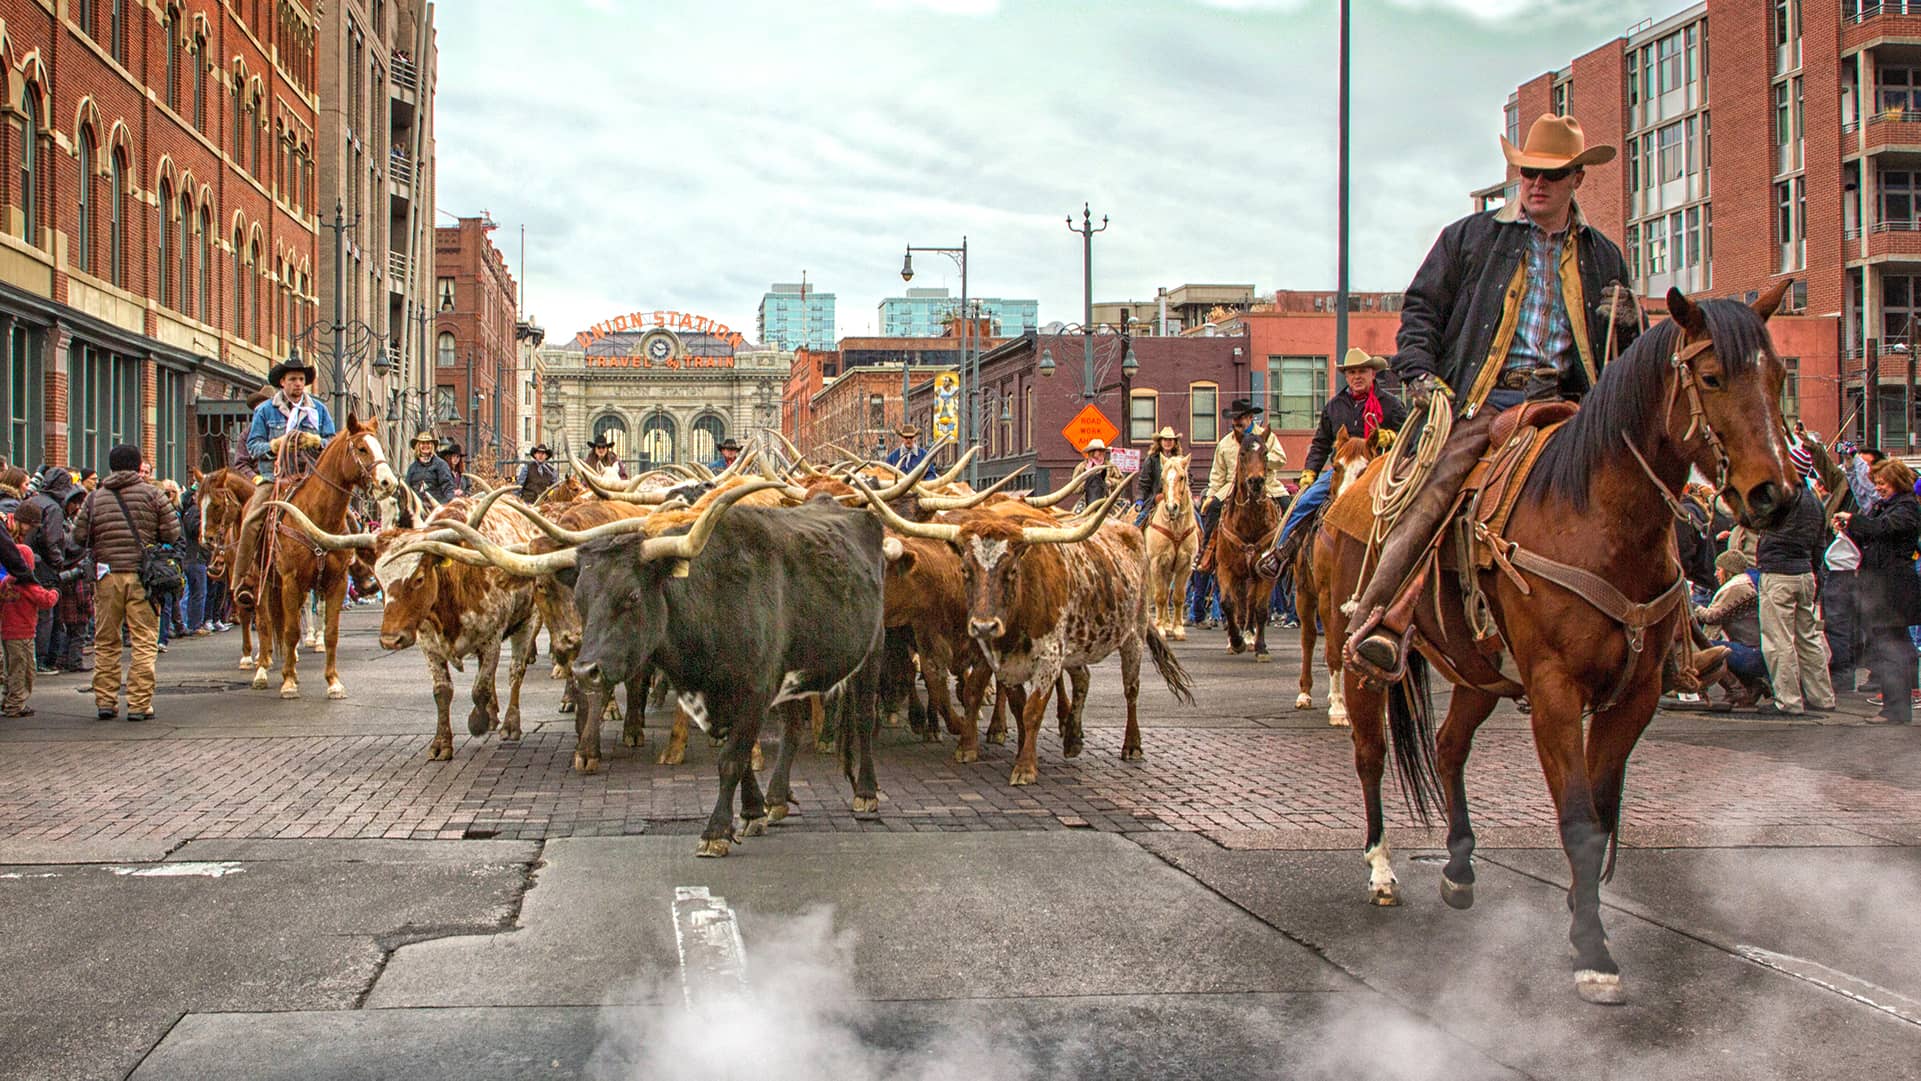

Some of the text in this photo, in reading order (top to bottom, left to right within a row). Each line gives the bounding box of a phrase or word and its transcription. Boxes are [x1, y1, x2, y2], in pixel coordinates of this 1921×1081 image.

[576, 310, 743, 350] UNION STATION
[586, 355, 734, 372] TRAVEL by TRAIN
[1081, 417, 1101, 425] ROAD
[1080, 427, 1102, 435] WORK
